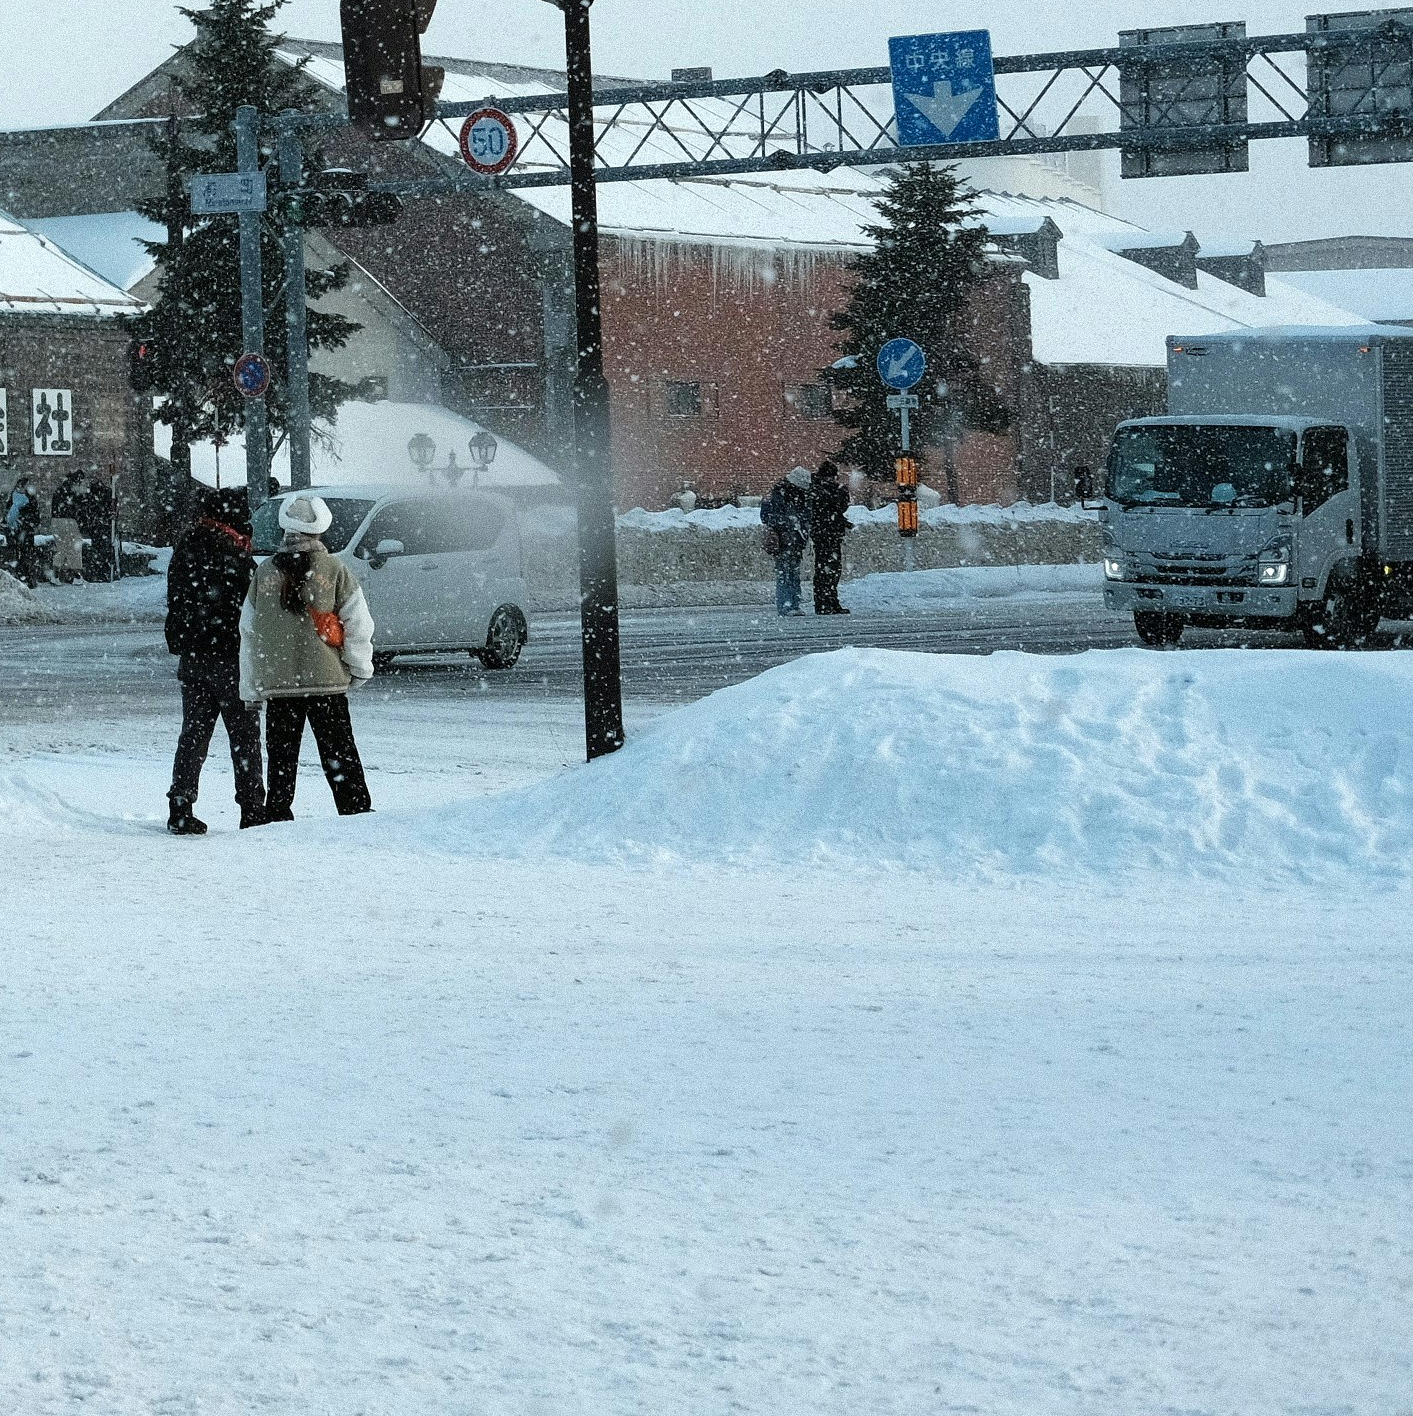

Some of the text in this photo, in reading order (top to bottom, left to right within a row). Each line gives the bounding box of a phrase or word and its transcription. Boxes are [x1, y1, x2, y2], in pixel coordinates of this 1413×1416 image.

[905, 47, 976, 73] 中央線
[473, 127, 504, 156] 50
